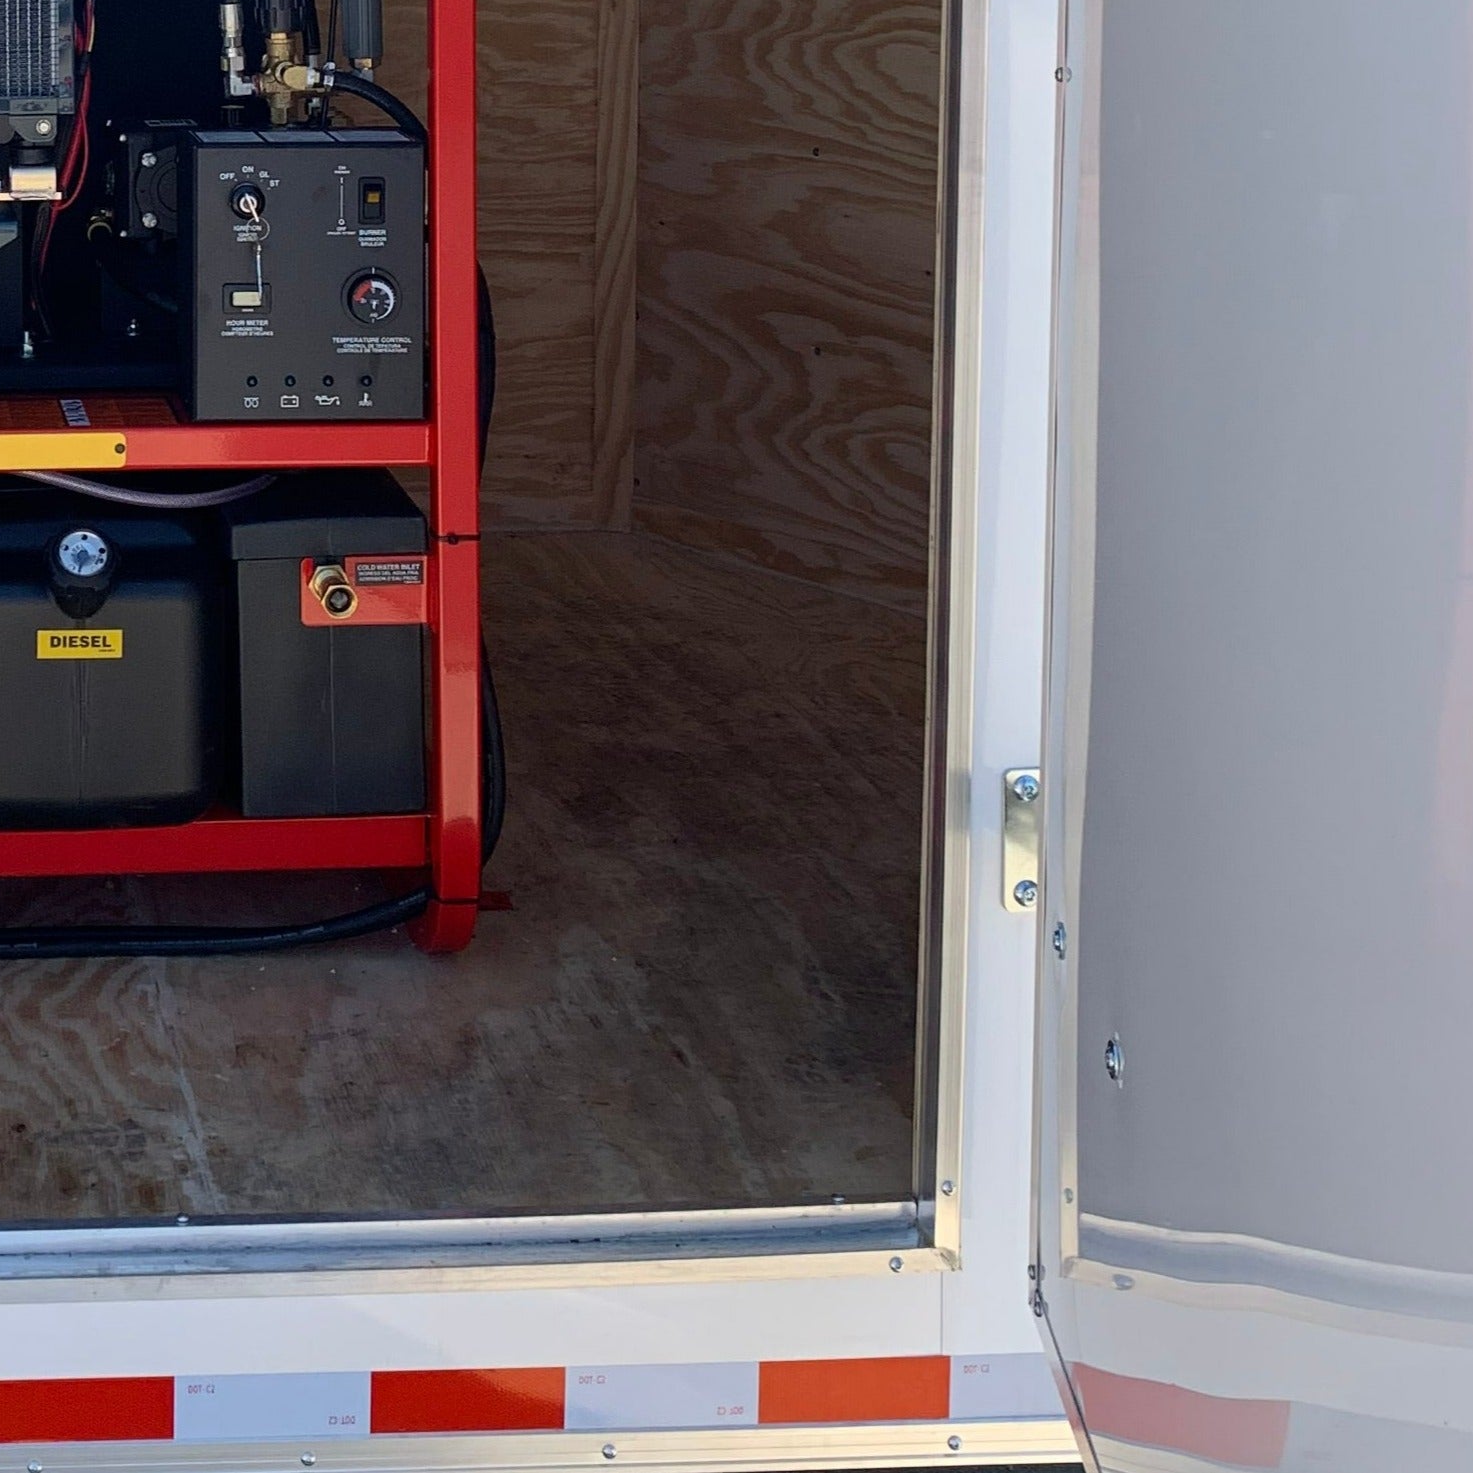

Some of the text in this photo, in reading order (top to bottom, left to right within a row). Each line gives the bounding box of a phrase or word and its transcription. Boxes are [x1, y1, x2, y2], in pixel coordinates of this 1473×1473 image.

[241, 165, 255, 173] ON
[219, 172, 236, 180] OFF
[380, 336, 412, 344] CONTROL
[357, 563, 376, 571] COLD
[49, 635, 112, 648] DIESEL
